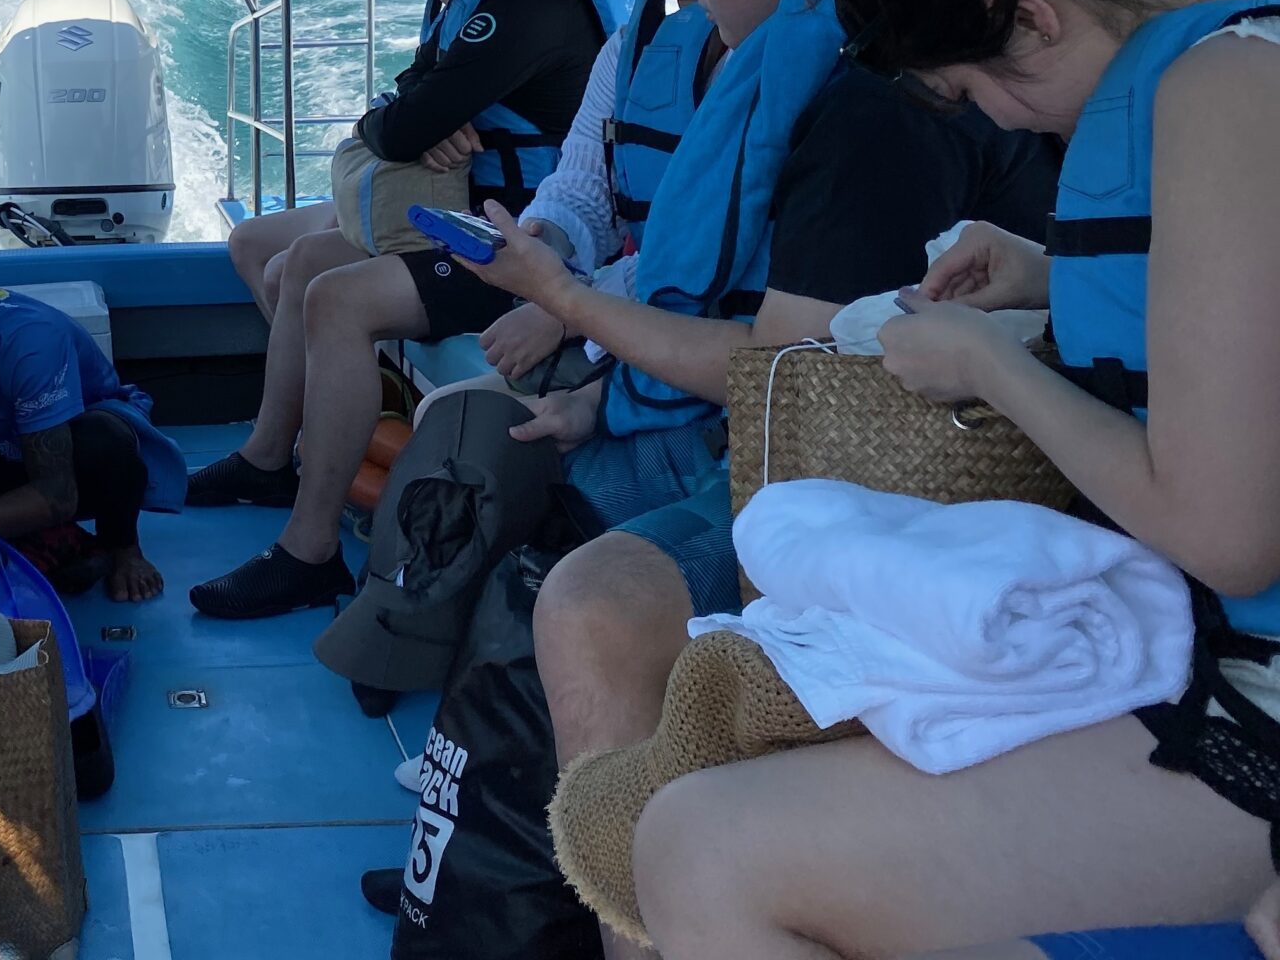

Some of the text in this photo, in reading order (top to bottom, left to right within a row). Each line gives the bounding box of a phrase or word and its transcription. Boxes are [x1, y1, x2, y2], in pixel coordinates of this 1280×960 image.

[47, 88, 106, 103] 200
[425, 726, 468, 779] cean
[420, 760, 459, 817] ack
